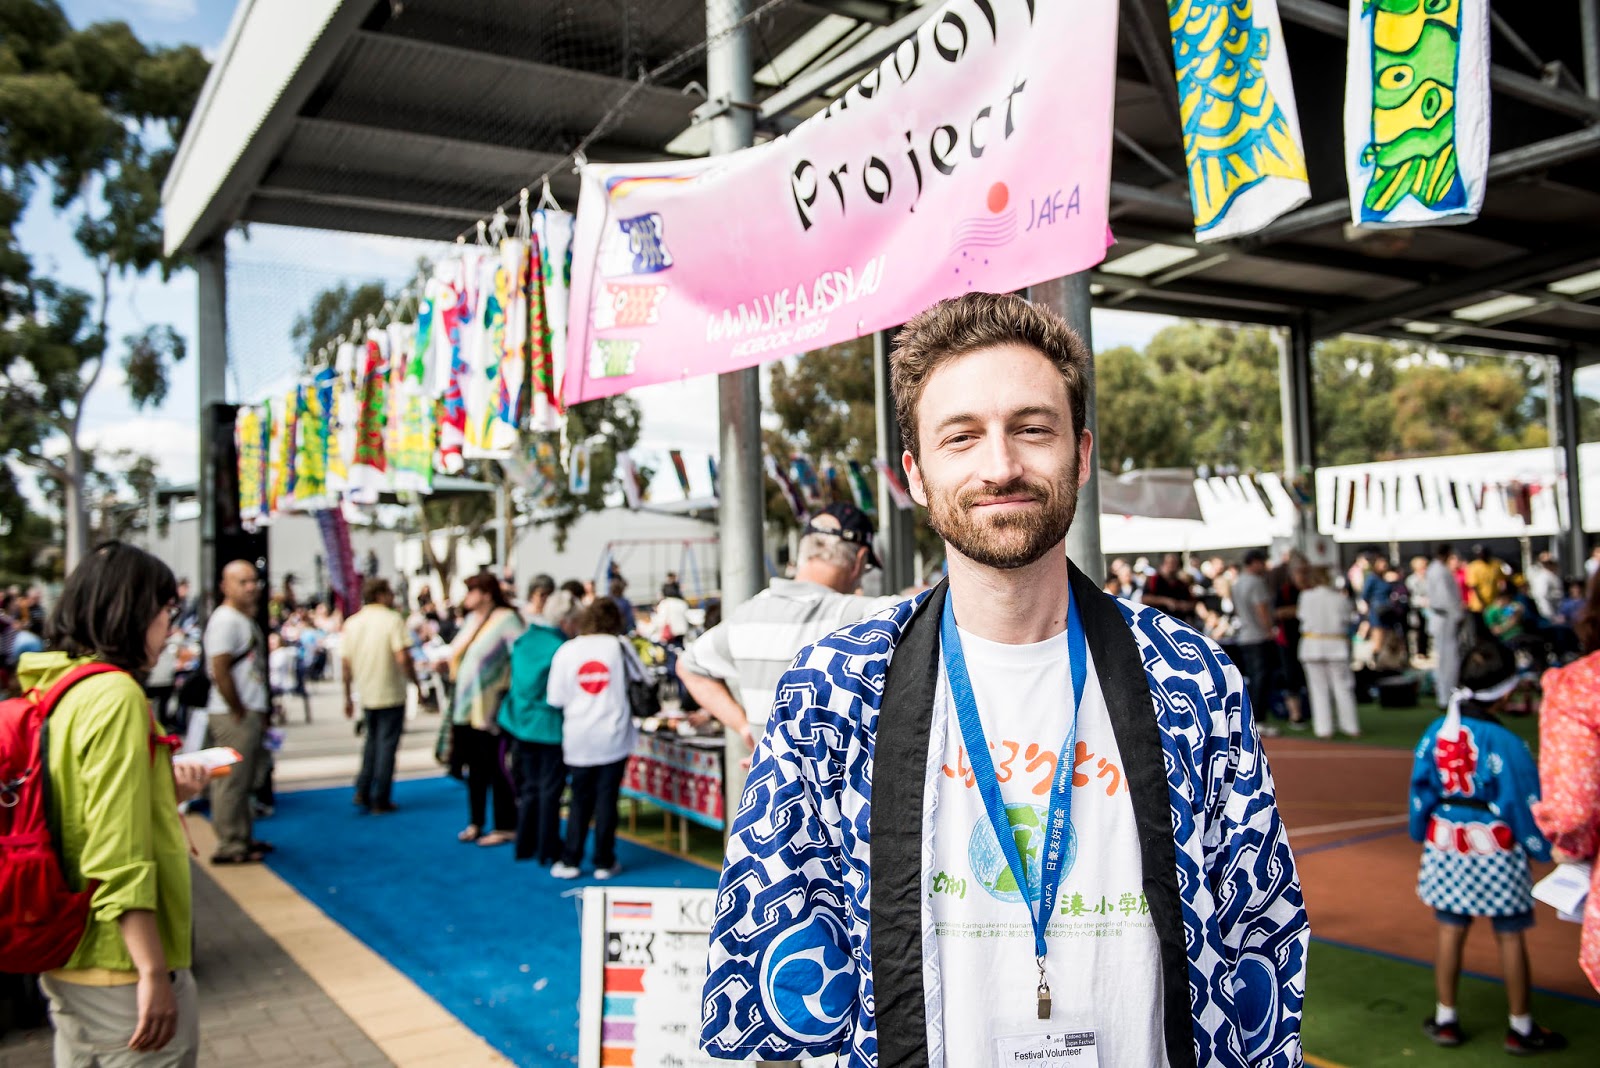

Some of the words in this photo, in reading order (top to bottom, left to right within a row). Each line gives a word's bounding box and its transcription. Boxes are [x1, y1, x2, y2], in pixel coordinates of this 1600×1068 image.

[790, 74, 1027, 232] Project
[1025, 184, 1080, 232] JAFA
[1044, 882, 1054, 910] JAFA
[962, 921, 995, 930] Earthquake
[1051, 921, 1072, 930] raising
[1074, 921, 1084, 929] for
[1095, 921, 1115, 929] people
[1124, 920, 1147, 928] Tohoku
[1014, 1049, 1044, 1061] Festival
[1045, 1048, 1082, 1058] Volunteer
